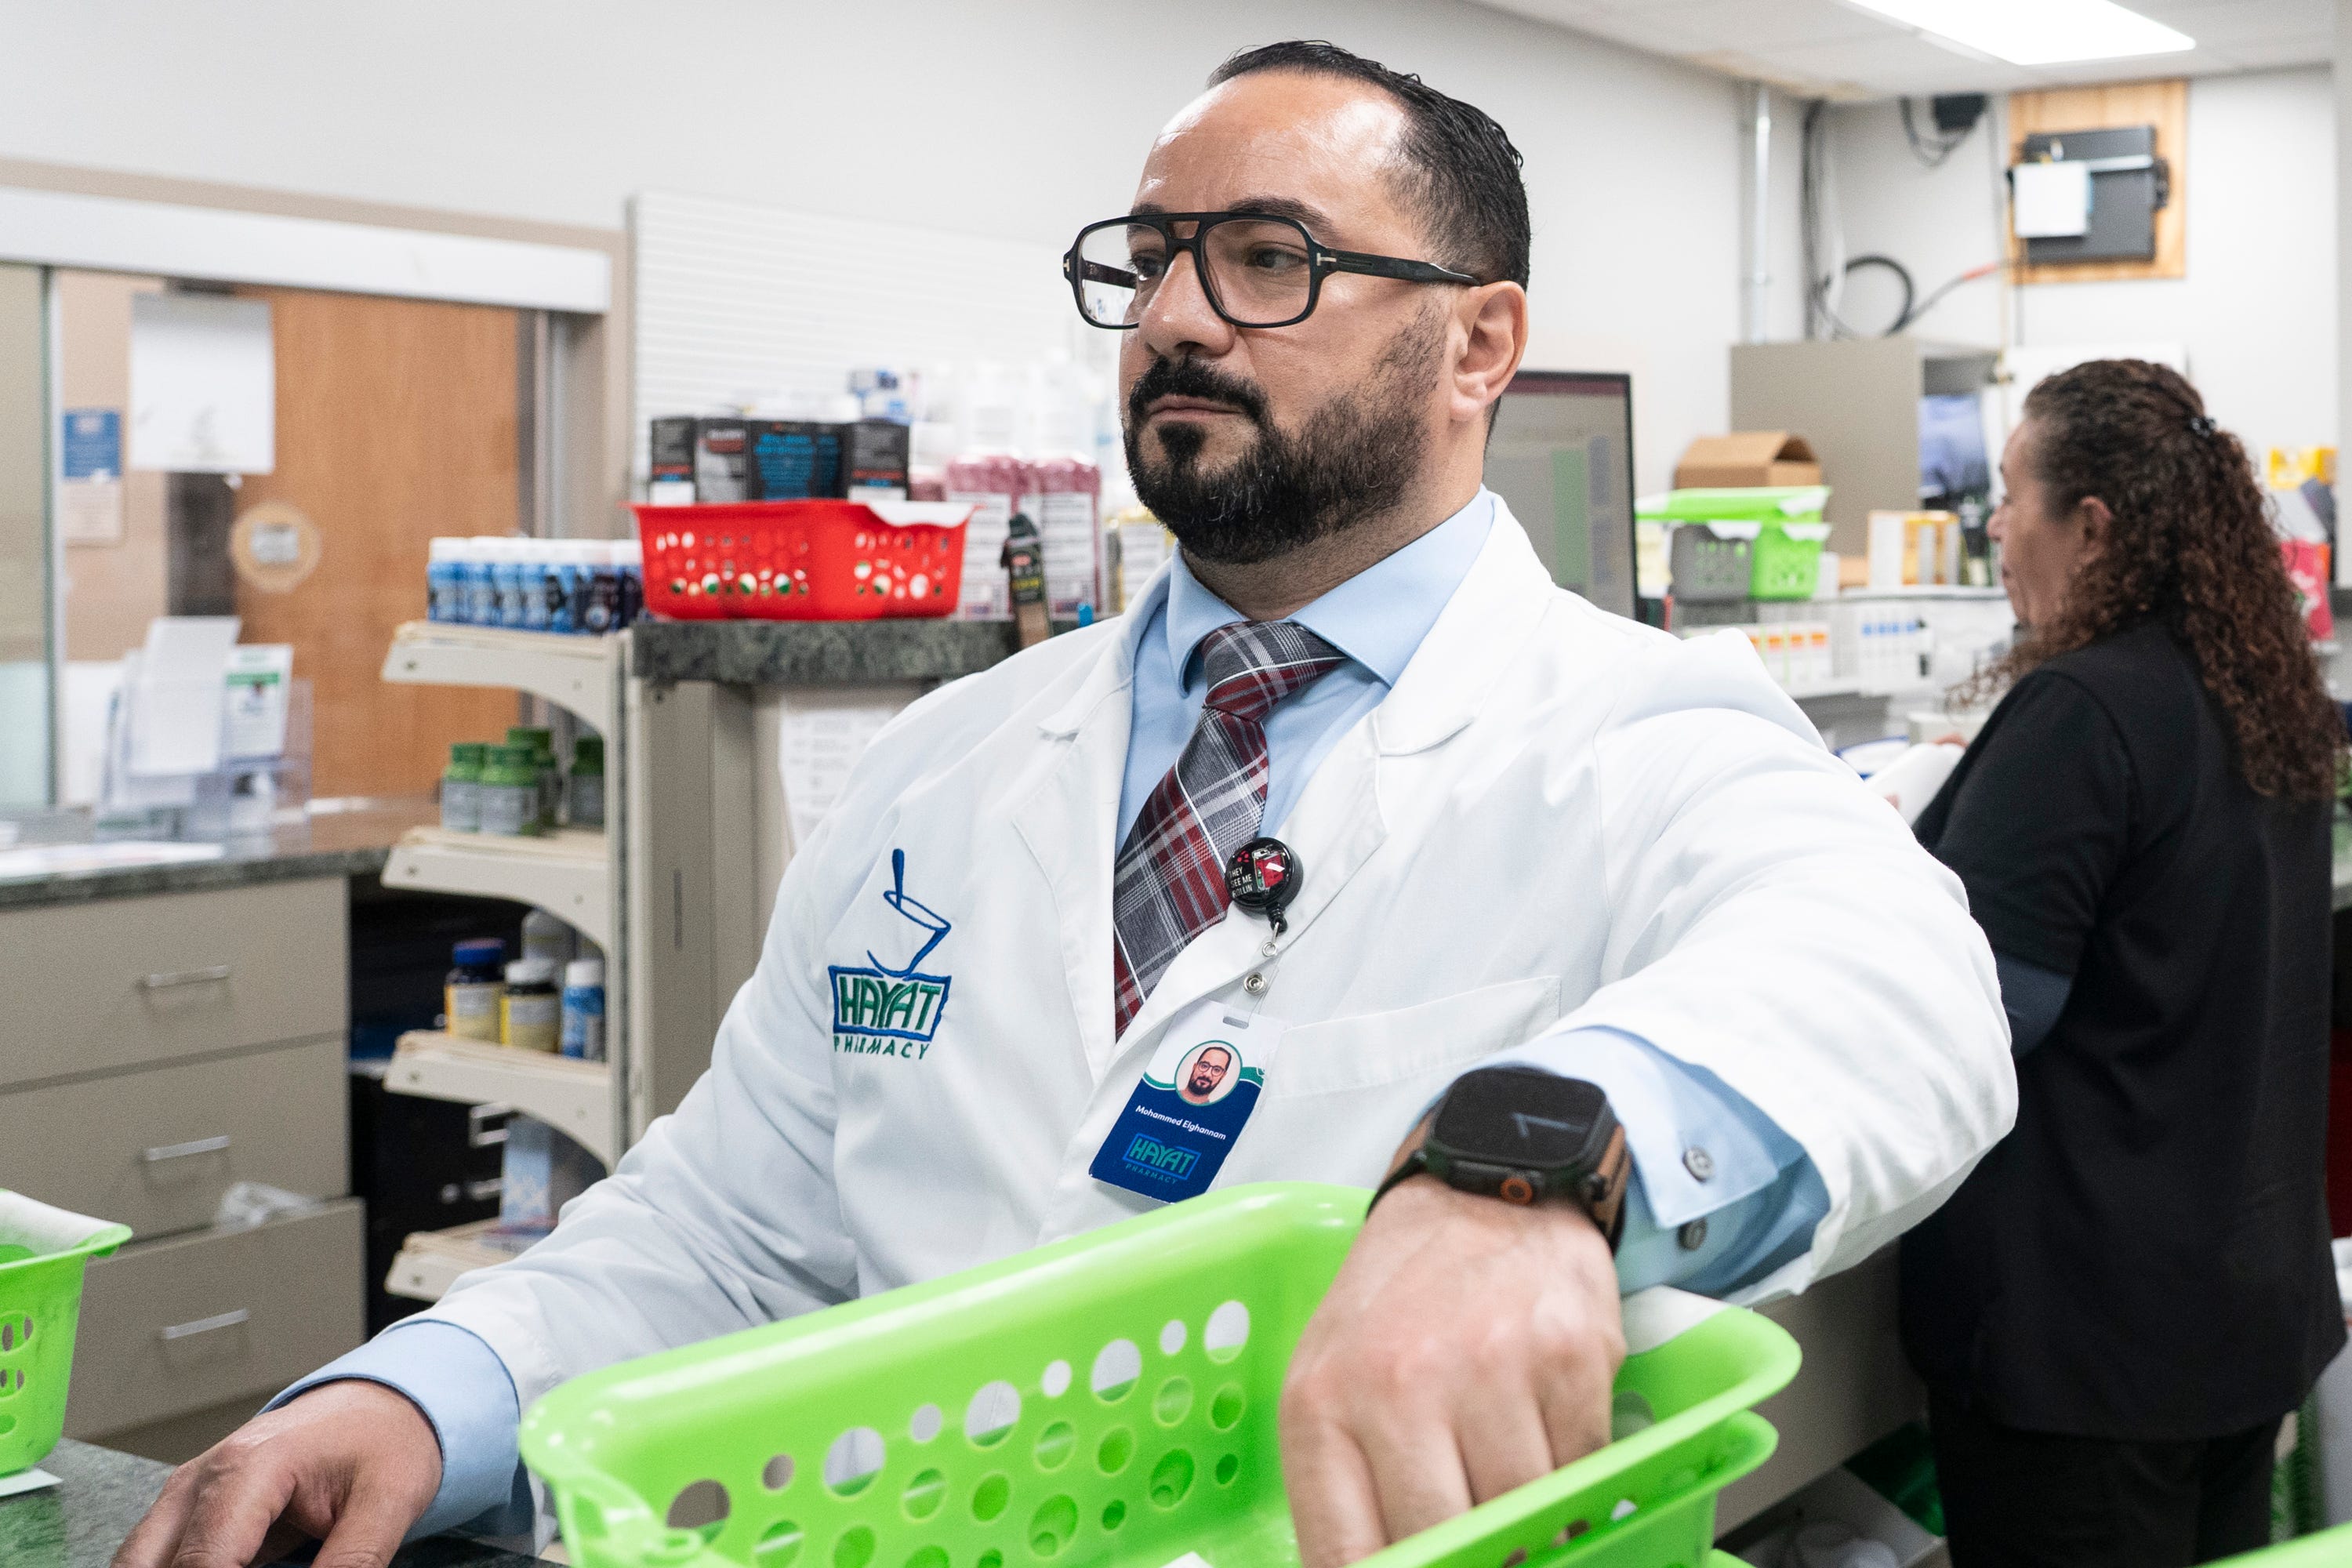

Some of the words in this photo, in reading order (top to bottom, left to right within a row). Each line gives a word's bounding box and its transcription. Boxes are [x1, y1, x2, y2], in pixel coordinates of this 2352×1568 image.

[1229, 866, 1243, 877] THEY
[1231, 878, 1241, 888] SEE
[1242, 873, 1252, 884] ME
[839, 976, 942, 1031] HAYAT
[1135, 1105, 1183, 1127] Mohammed
[1182, 1120, 1226, 1140] Elghannam
[1129, 1138, 1195, 1174] HAYAT
[1125, 1163, 1178, 1185] PHARMACY
